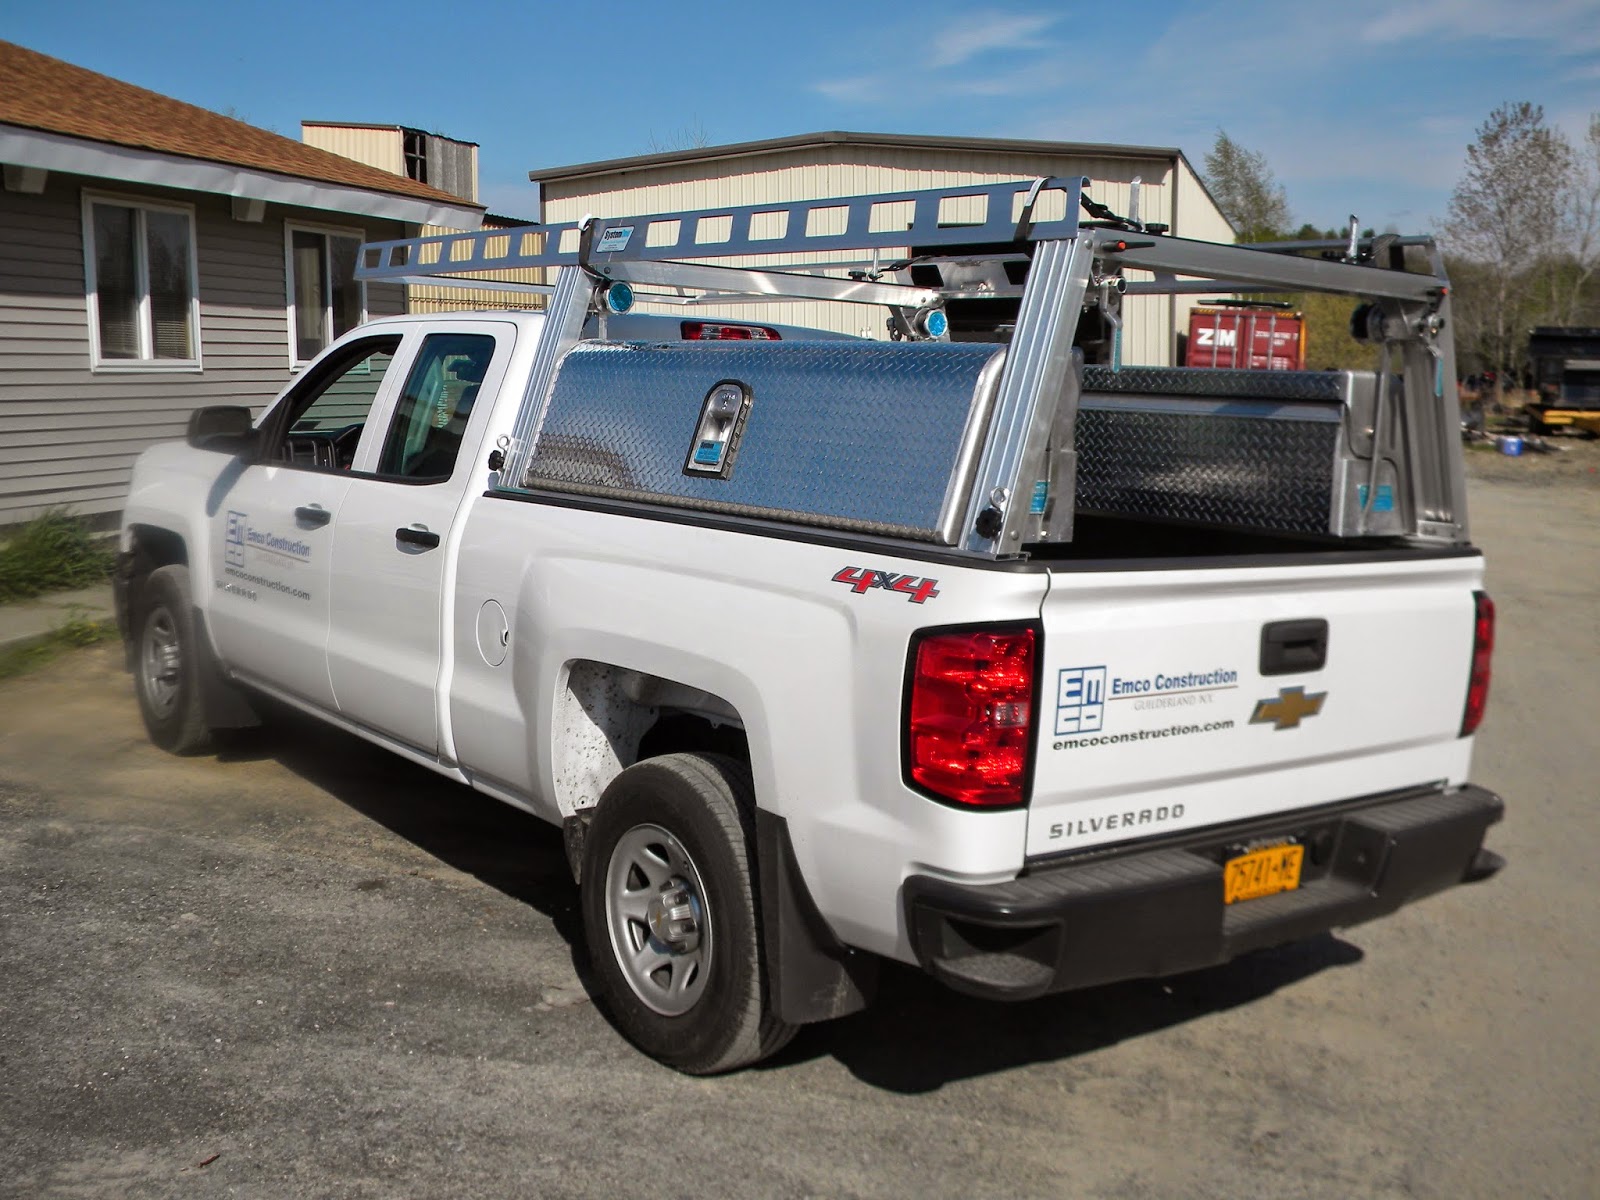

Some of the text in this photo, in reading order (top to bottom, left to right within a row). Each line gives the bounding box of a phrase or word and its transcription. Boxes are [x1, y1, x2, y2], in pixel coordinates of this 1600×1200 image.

[266, 532, 311, 557] Construction
[224, 567, 310, 601] emcoconstruction.com
[1112, 668, 1238, 695] Emco Construction
[1053, 720, 1235, 751] emcoconstruction.com
[1049, 803, 1185, 839] SILVERADO
